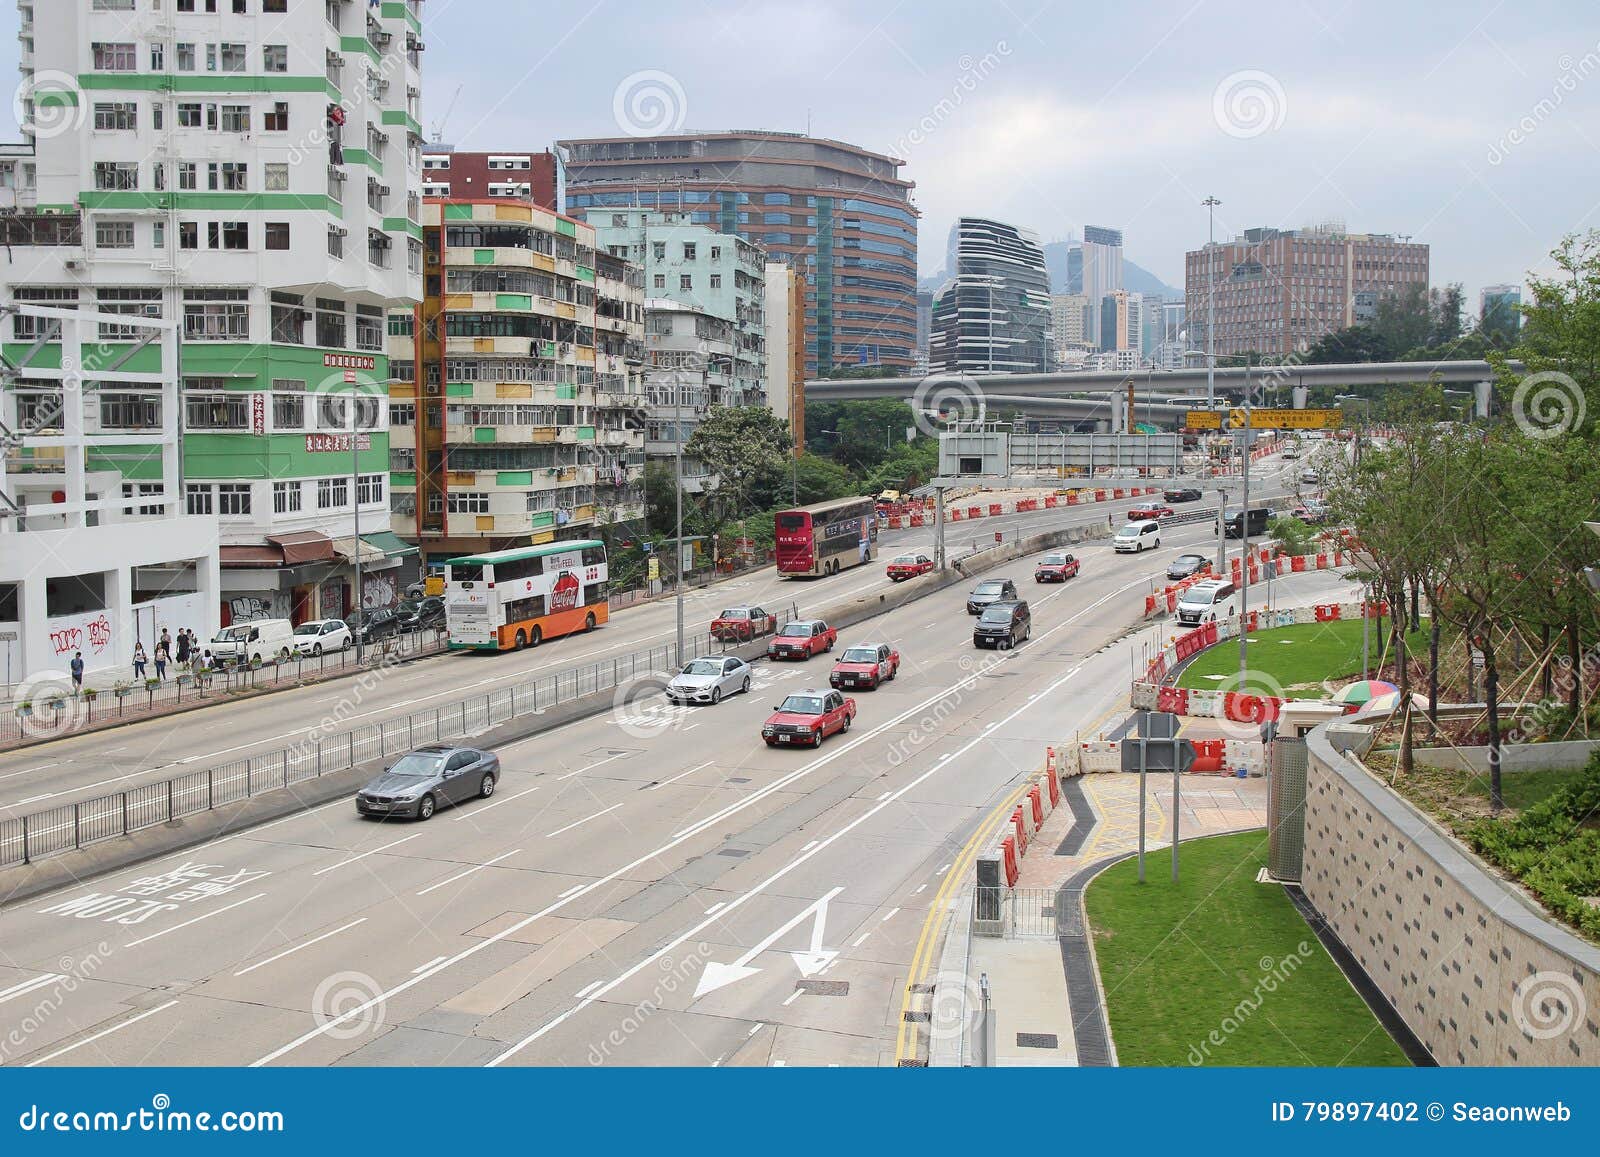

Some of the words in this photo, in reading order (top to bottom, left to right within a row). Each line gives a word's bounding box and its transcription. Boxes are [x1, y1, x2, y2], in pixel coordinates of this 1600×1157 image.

[306, 435, 349, 452] 東江安老院
[36, 893, 179, 924] SLOW
